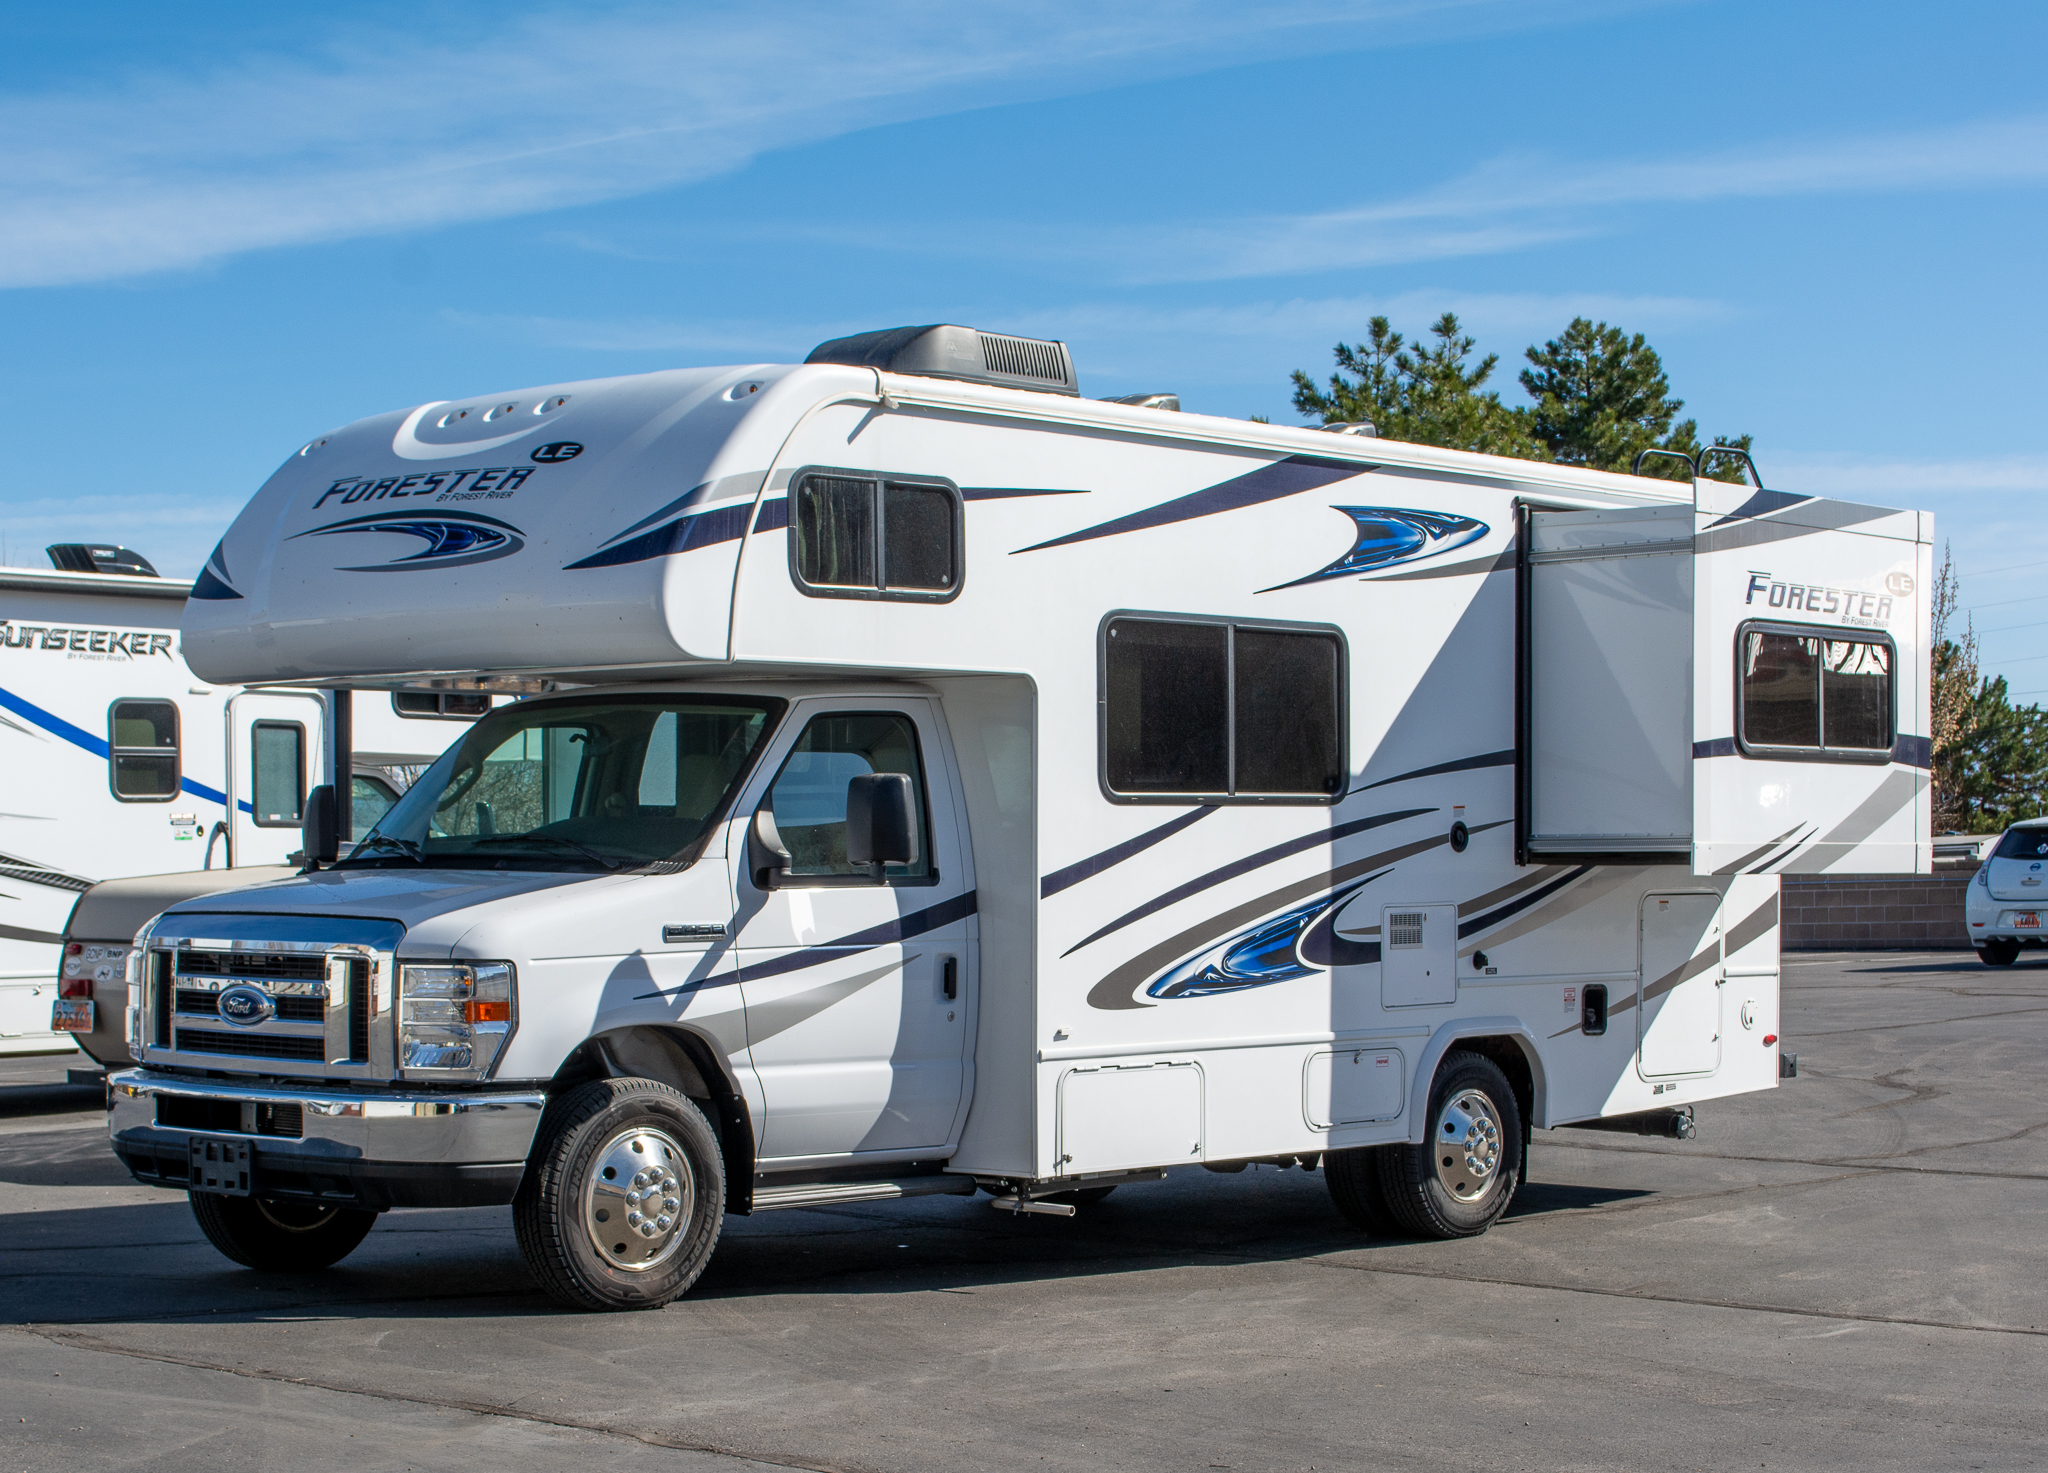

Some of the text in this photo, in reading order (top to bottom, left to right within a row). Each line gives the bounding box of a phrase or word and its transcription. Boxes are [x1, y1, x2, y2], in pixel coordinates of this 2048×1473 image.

[535, 444, 581, 459] LE
[312, 466, 538, 510] FORESTER
[451, 492, 487, 502] FOREST
[488, 489, 514, 500] RIVER
[1887, 575, 1912, 592] LE
[1745, 570, 1893, 620] FORESTER
[1850, 616, 1872, 627] FOREST
[1872, 618, 1889, 628] RIVER
[79, 653, 105, 661] FOREST
[106, 654, 127, 662] RIVER
[106, 950, 123, 958] BNP
[227, 996, 252, 1014] Ford
